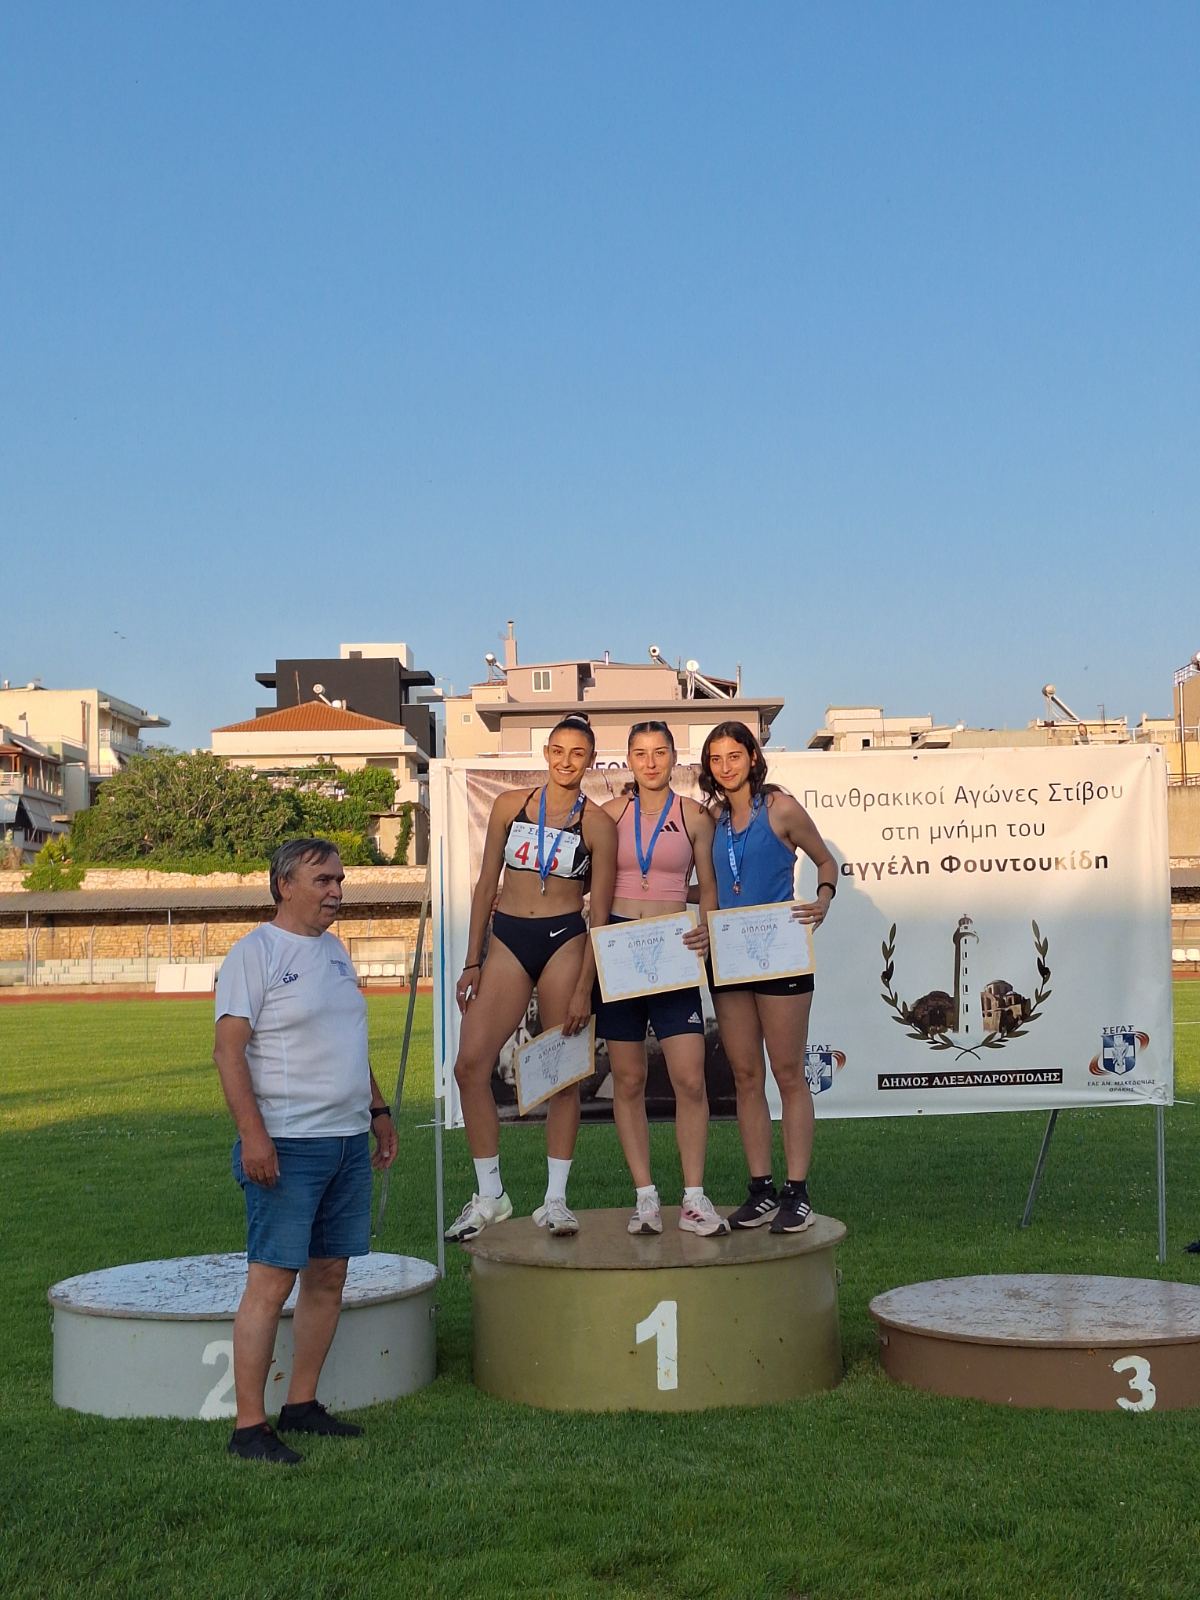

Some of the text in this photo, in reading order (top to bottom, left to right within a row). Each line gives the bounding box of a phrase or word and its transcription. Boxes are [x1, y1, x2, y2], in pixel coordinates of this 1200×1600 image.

[804, 781, 1123, 812] Πανθρακικοί Αγώνες Στίβου
[881, 819, 1045, 845] στη μνήμη του
[840, 850, 1108, 881] αγγέλη Φουντουκίδη
[1102, 1025, 1135, 1035] ΣΕΓΑΣ
[805, 1044, 832, 1053] ΕΓΑΣ
[881, 1072, 1061, 1088] ΔΗΜΟΣ ΑΛΕΞΑΝΔΡΟΥΠΟΛΗΣ
[635, 1300, 678, 1390] 1
[199, 1340, 238, 1420] 2
[1112, 1354, 1156, 1412] 3
